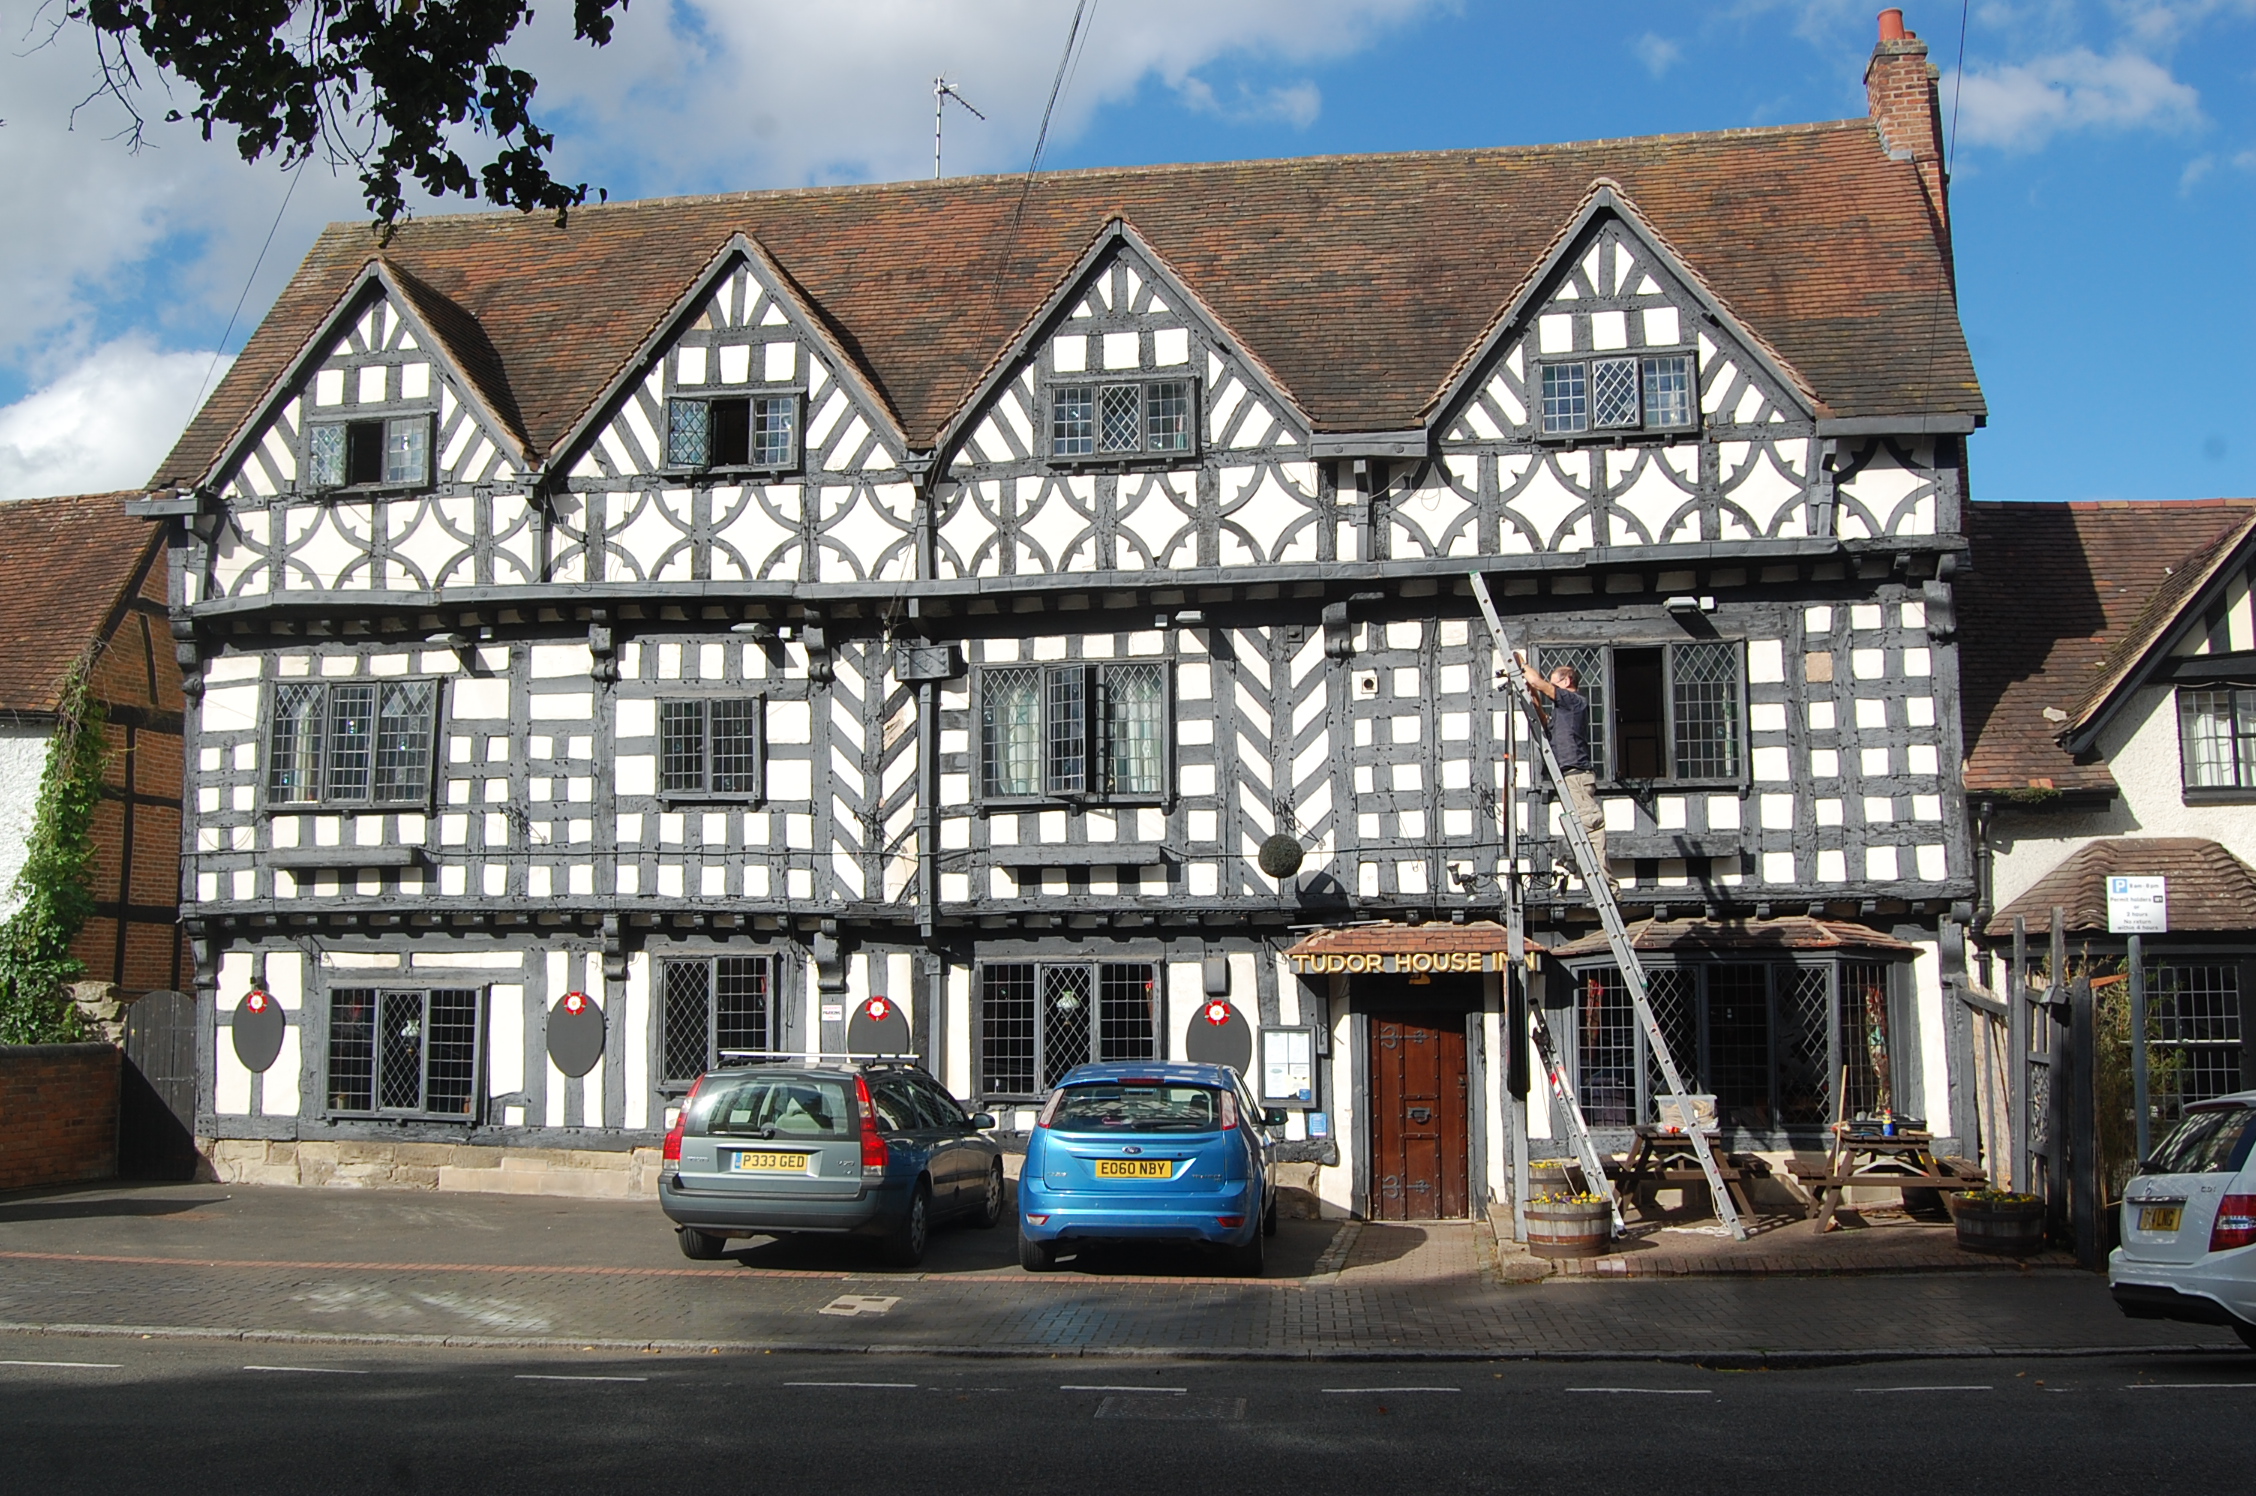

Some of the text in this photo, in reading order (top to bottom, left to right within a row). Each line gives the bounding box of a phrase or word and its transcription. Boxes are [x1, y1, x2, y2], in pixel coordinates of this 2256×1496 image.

[1292, 953, 1385, 973] TUDOR
[1395, 952, 1482, 972] HOUSE
[743, 1154, 805, 1168] P333 GED
[1139, 1162, 1165, 1175] NBY
